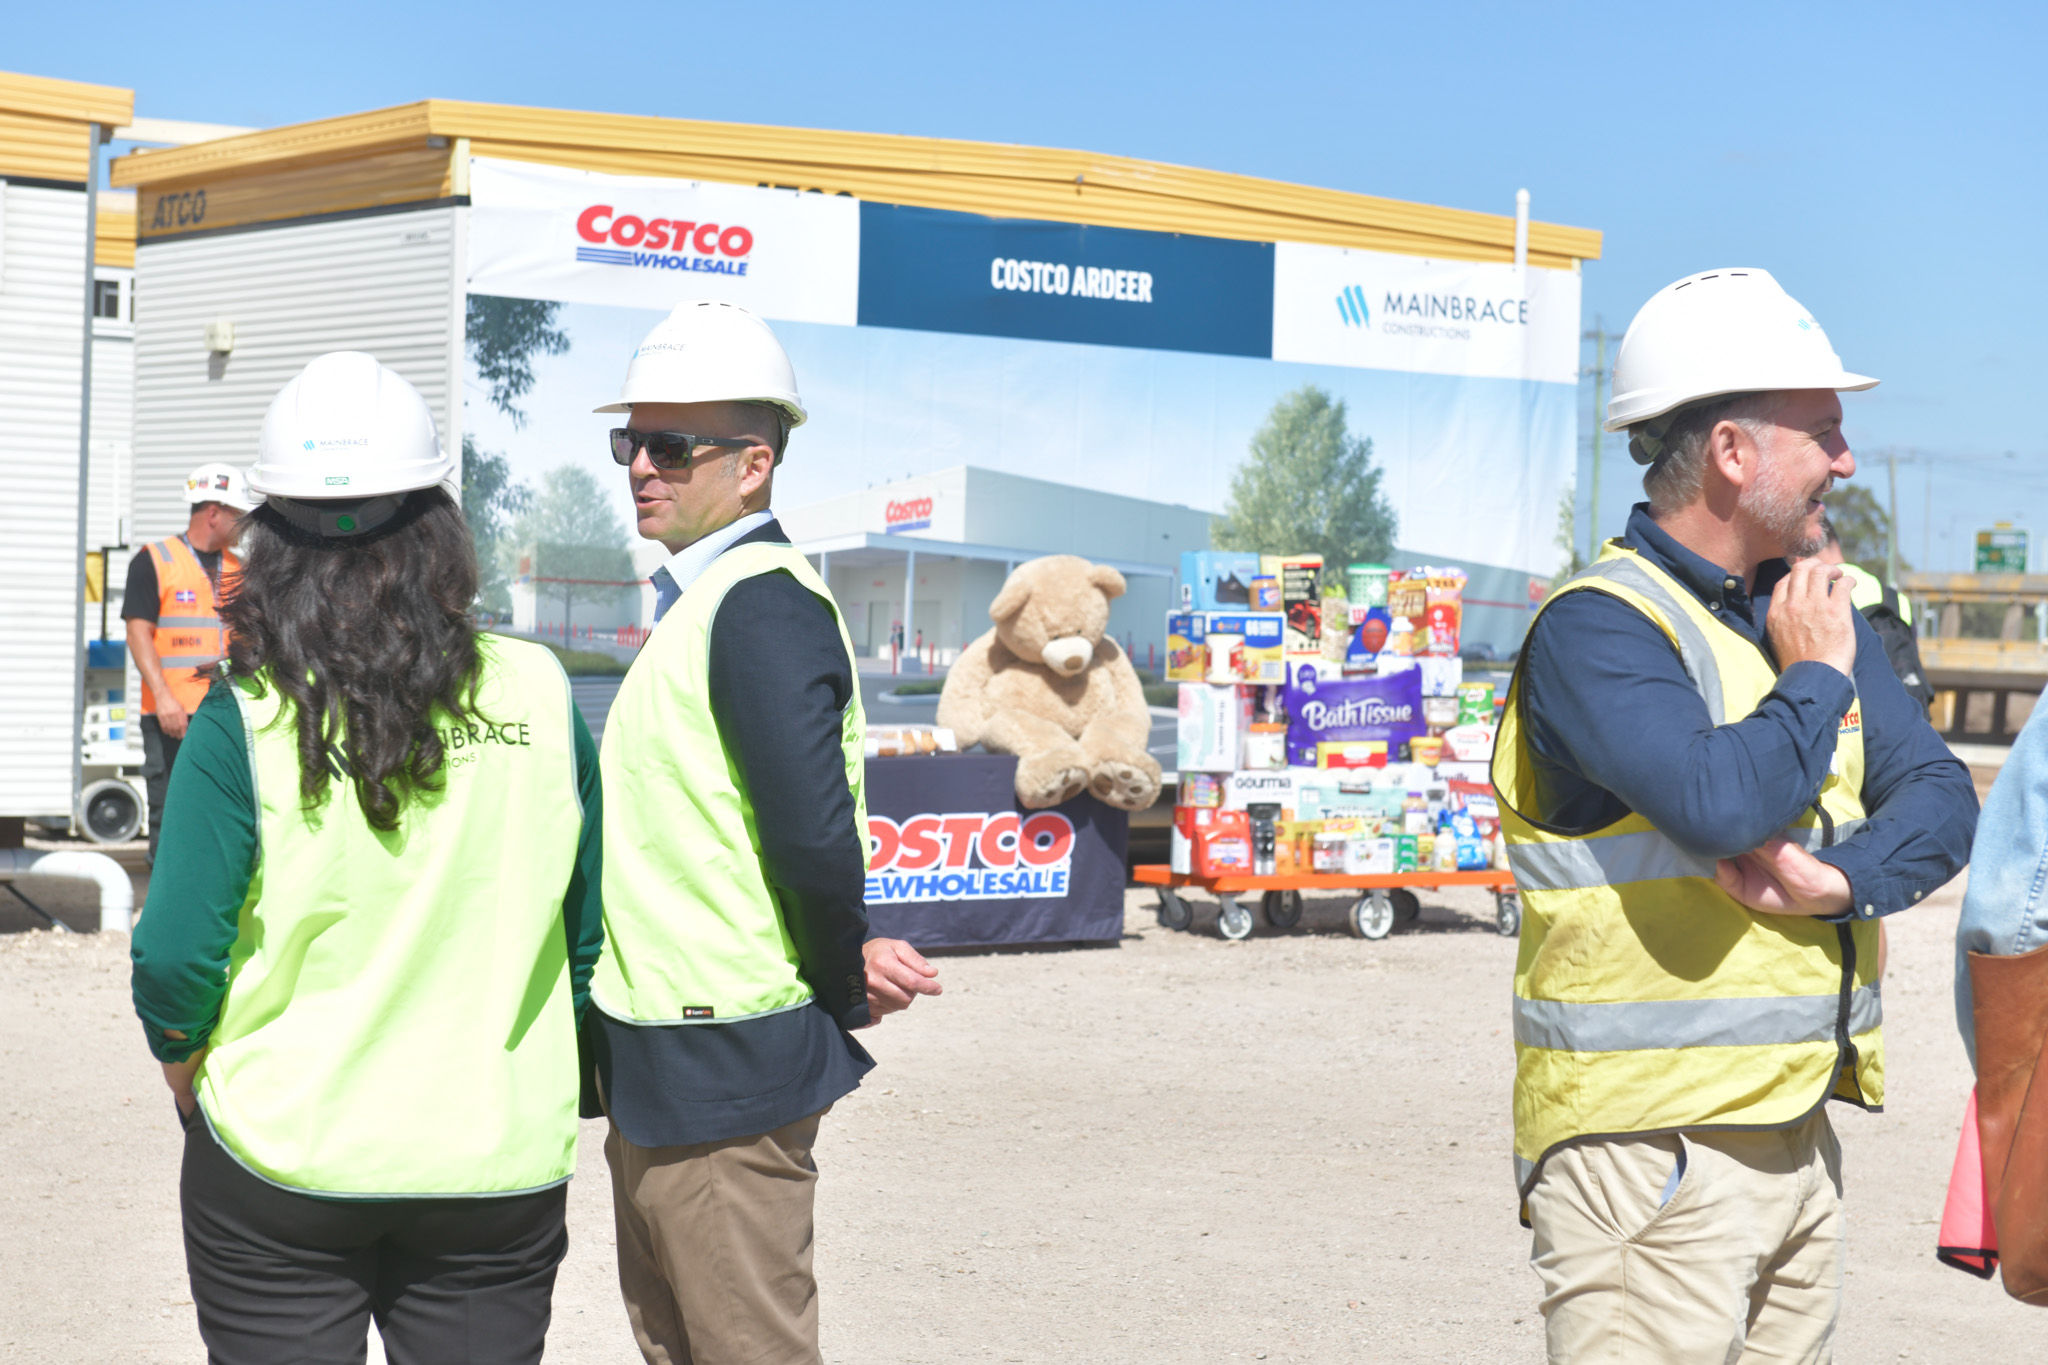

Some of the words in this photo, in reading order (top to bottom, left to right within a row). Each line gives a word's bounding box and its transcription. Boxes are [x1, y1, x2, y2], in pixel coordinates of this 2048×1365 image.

[151, 189, 207, 230] ATCO
[576, 204, 754, 258] COSTCO
[633, 251, 748, 276] WHOLESALE
[991, 257, 1070, 295] COSTCO
[1071, 265, 1153, 303] ARDEER
[1384, 291, 1529, 325] MAINBRACE
[1382, 322, 1471, 340] CONSTRUCTIONS
[320, 438, 369, 447] MAINBRACE
[325, 477, 350, 485] MSA
[172, 636, 202, 648] UNION
[1301, 698, 1358, 731] Bath
[1356, 697, 1412, 727] Tissue
[867, 814, 1073, 872] OSTCO
[881, 871, 1067, 899] WHOLESALE
